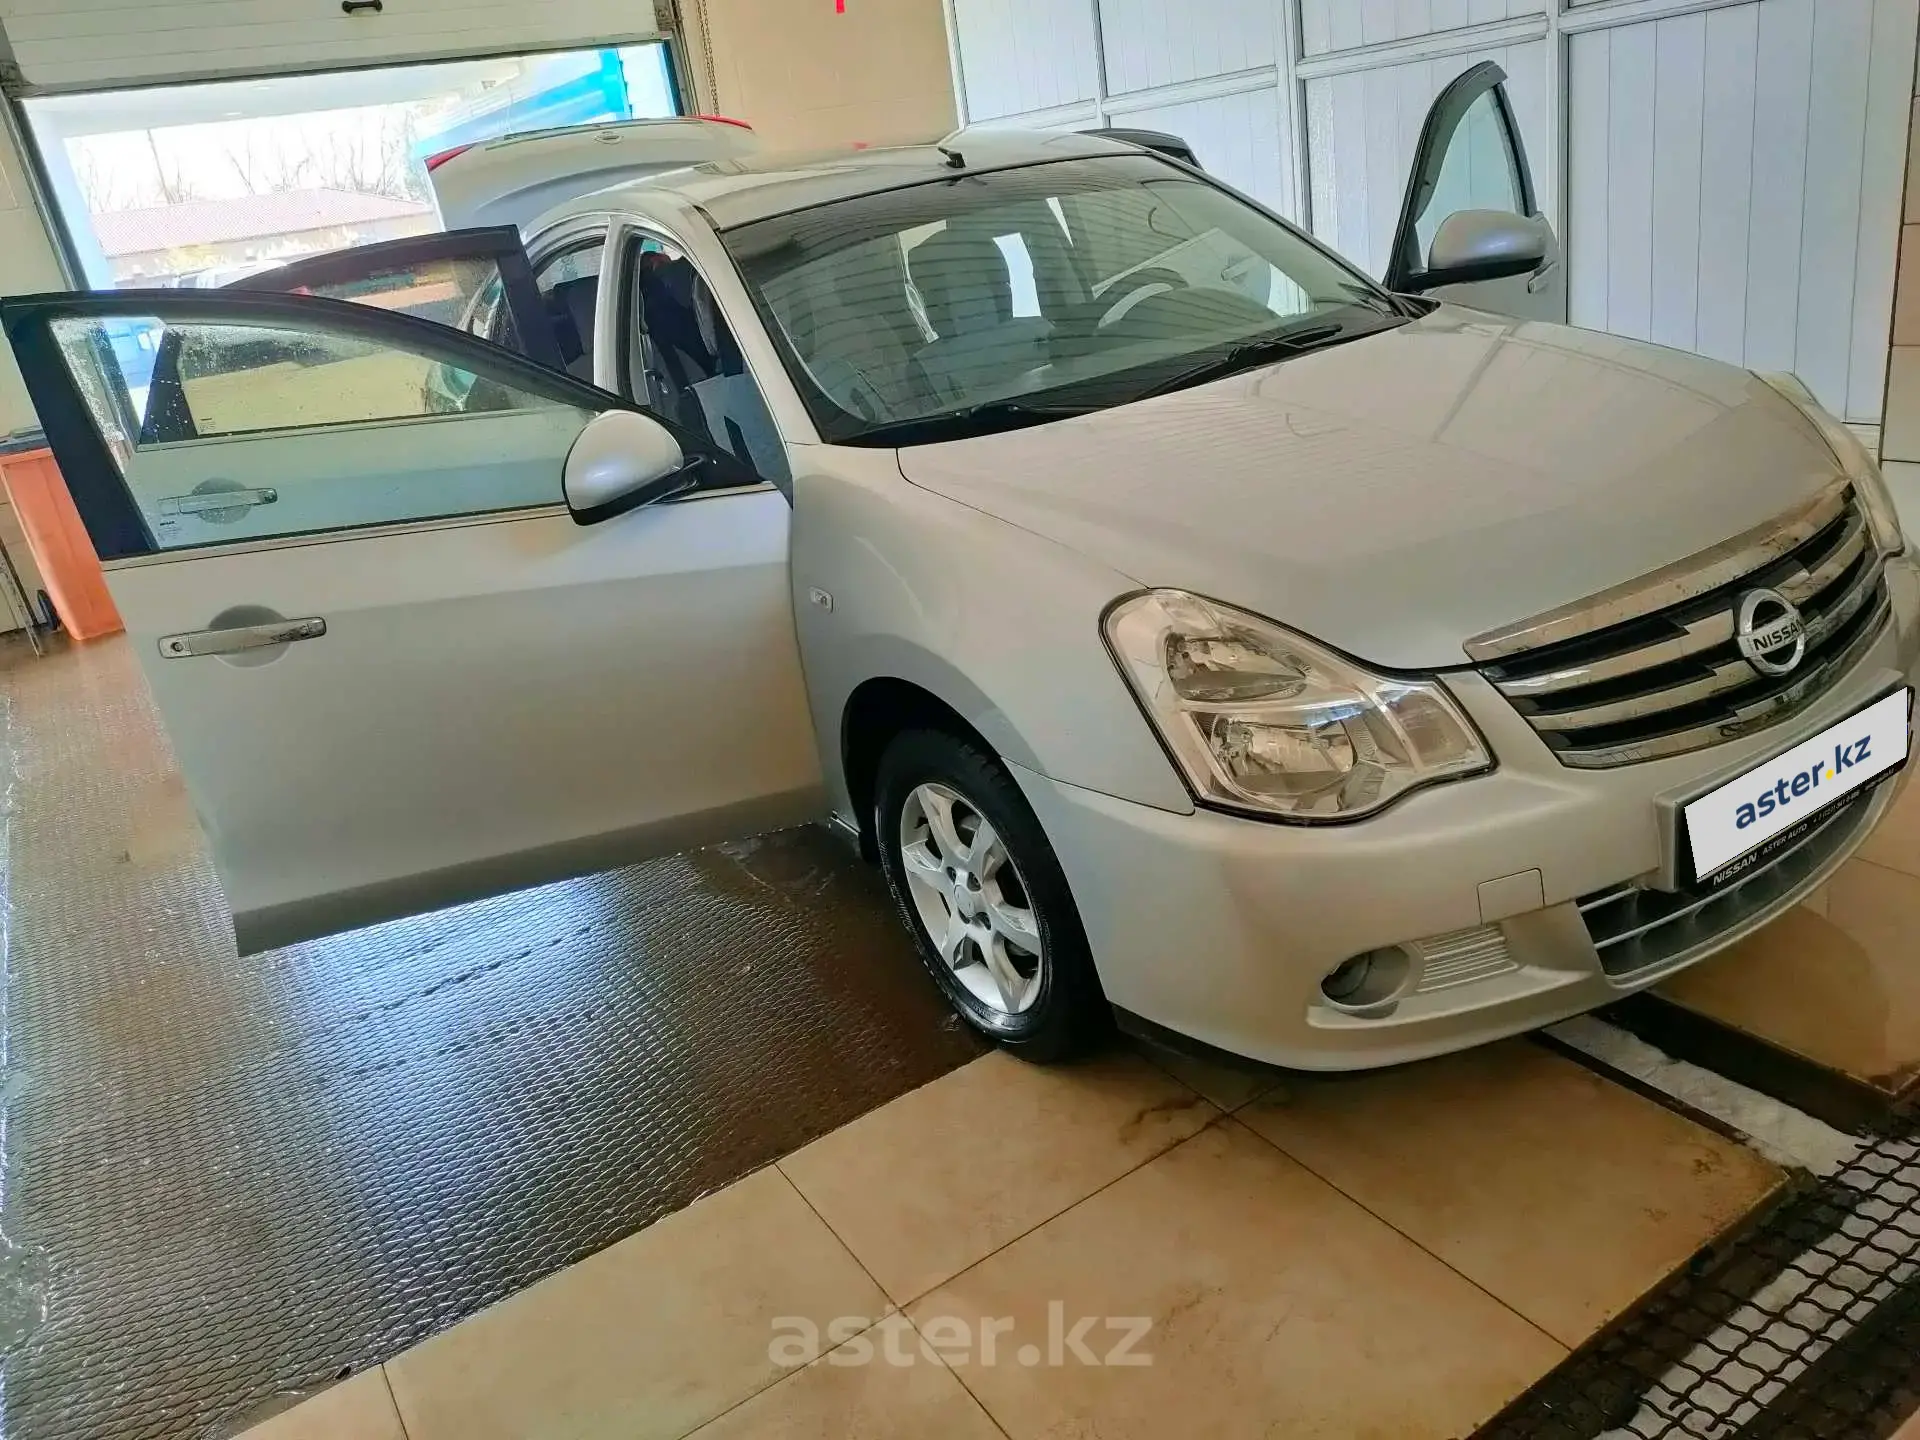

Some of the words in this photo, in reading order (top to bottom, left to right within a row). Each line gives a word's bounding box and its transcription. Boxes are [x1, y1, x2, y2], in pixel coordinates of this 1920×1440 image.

[1713, 852, 1758, 885] NISSAN
[1762, 836, 1787, 855] ASTER
[1788, 823, 1808, 840] AUTO
